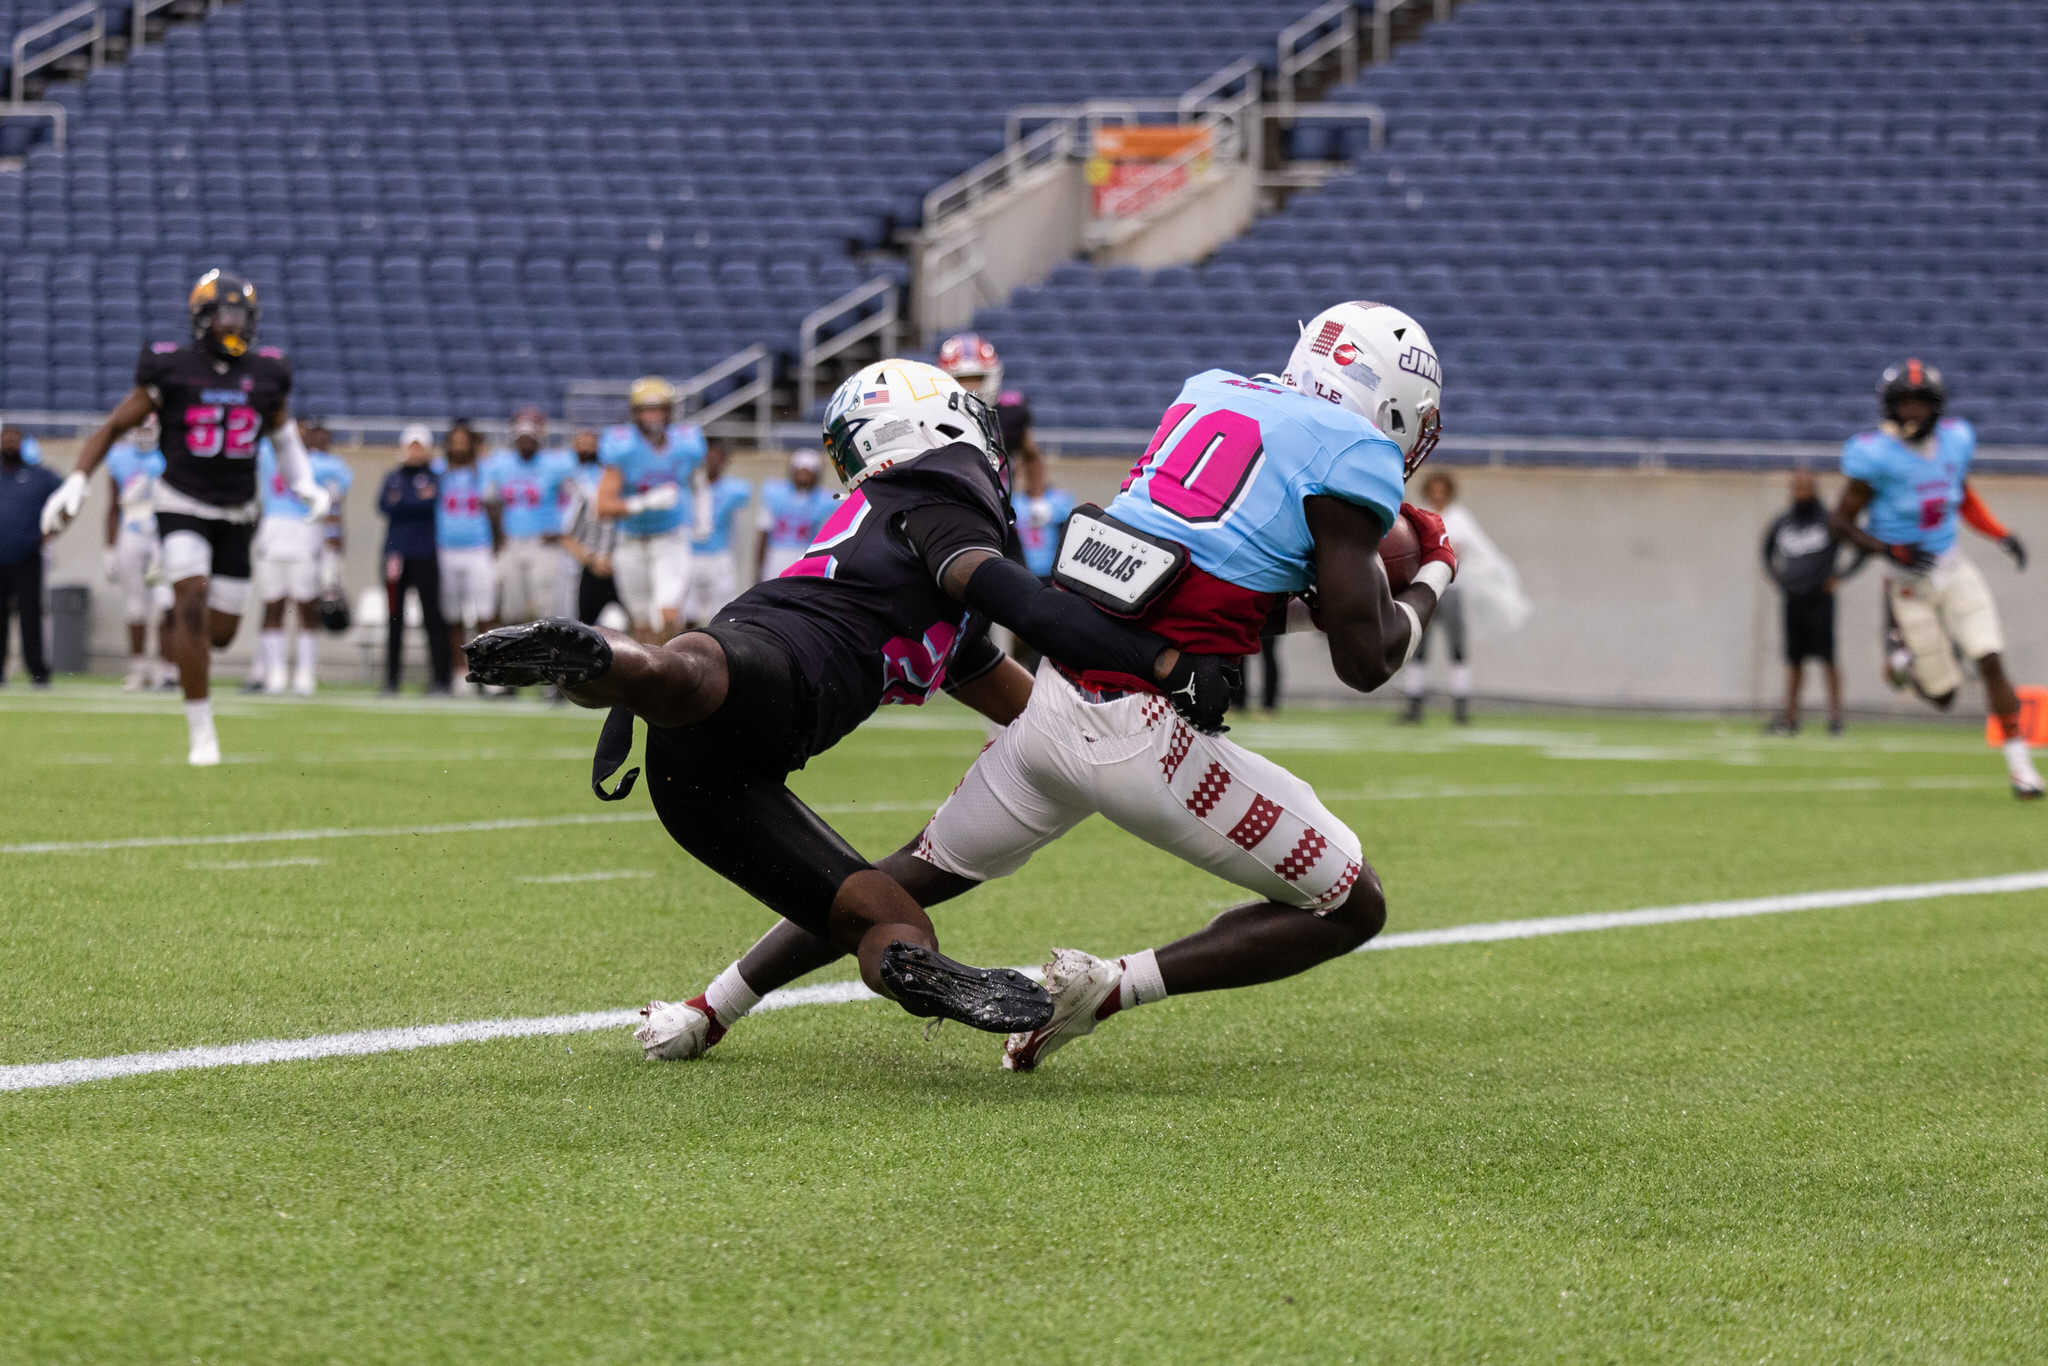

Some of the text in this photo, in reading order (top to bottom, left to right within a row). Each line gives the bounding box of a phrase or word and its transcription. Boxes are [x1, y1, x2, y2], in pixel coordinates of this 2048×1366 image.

[1282, 373, 1343, 405] TELE
[185, 405, 261, 458] 52
[1072, 536, 1142, 583] DOUGLAS
